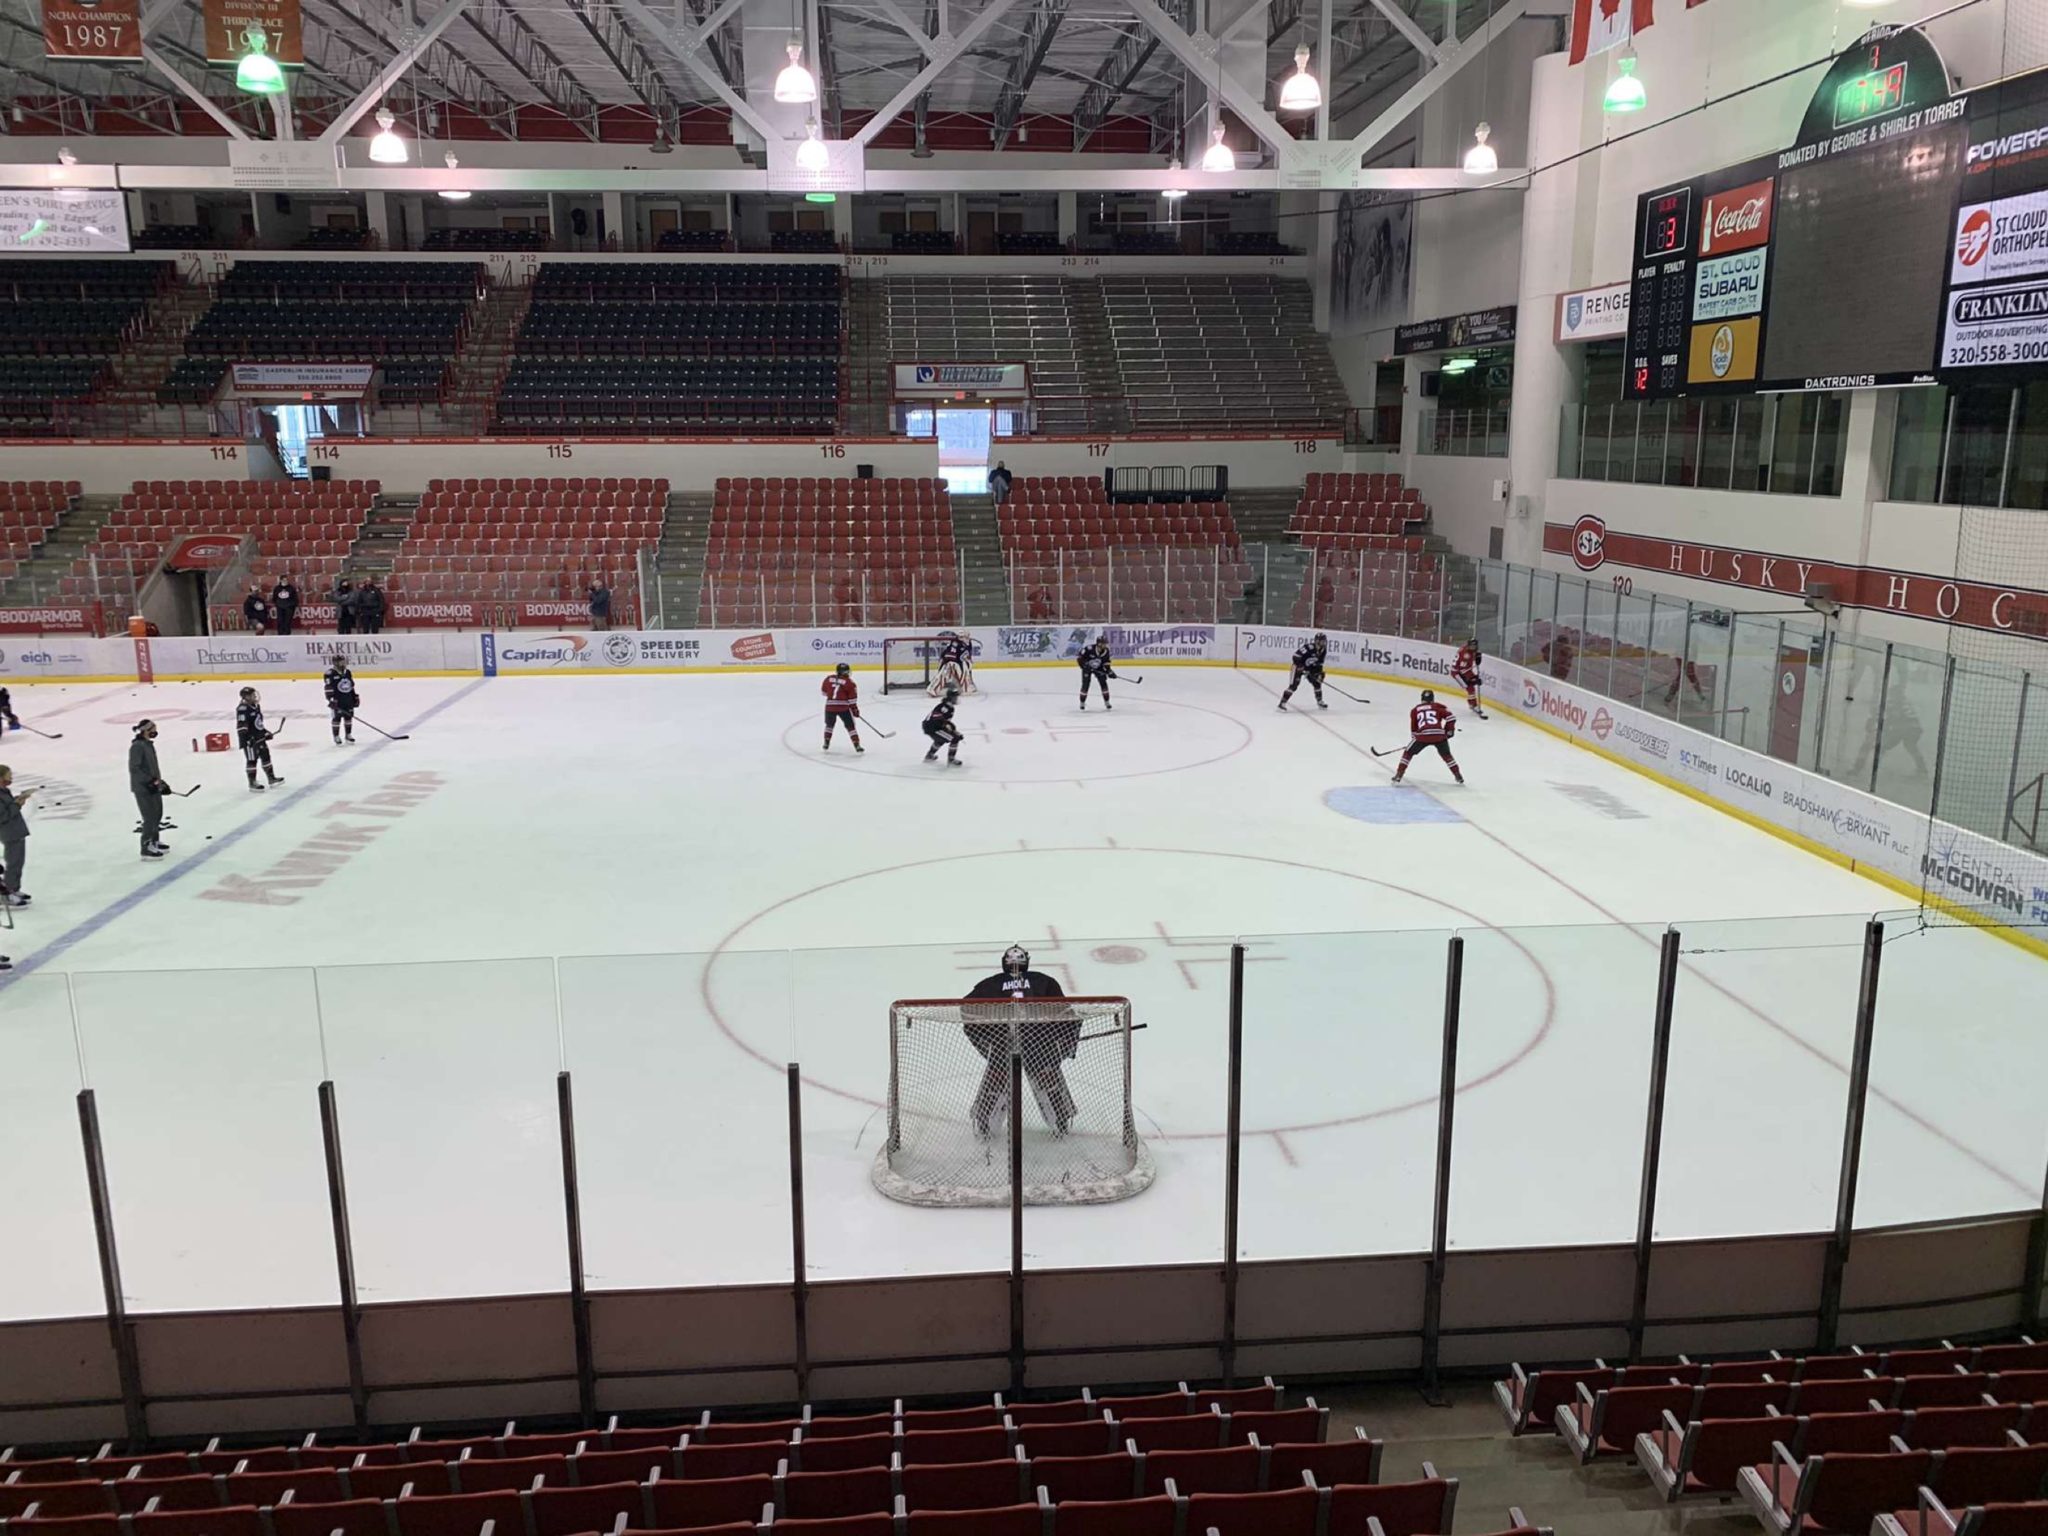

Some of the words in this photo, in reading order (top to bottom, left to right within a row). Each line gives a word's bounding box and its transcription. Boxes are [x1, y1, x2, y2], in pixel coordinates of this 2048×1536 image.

[48, 11, 78, 21] NCHA
[78, 12, 132, 22] CHAMPION
[62, 25, 122, 48] 1987
[225, 29, 284, 53] 197
[1778, 144, 1817, 169] DONATED
[1818, 140, 1831, 157] BY
[1831, 128, 1868, 153] GEORGE
[1869, 125, 1877, 141] &
[1879, 113, 1922, 139] SHIRLEY
[1924, 97, 1968, 126] TORREY
[1994, 216, 2009, 236] ST
[2010, 209, 2047, 233] CLOUD
[181, 252, 199, 261] 210
[212, 252, 229, 261] 211
[489, 254, 505, 262] 211
[520, 254, 537, 263] 212
[846, 256, 863, 265] 212
[871, 256, 888, 265] 213
[1061, 257, 1077, 266] 213
[1084, 257, 1100, 266] 214
[1269, 257, 1285, 266] 214
[1637, 266, 1657, 280] PLAYER
[1663, 260, 1686, 275] PENALTY
[1700, 264, 1719, 279] ST.
[1720, 255, 1760, 276] CLOUD
[1699, 274, 1760, 300] SUBARU
[1585, 292, 1630, 315] RENGE
[1958, 290, 2048, 321] FRANKLIN
[1956, 329, 1994, 342] OUTDOOR
[1995, 323, 2048, 338] ADVERTISING
[1949, 341, 2048, 365] 320-558-3000
[940, 366, 1004, 383] ULTIMATE
[1635, 368, 1648, 390] 12
[1804, 374, 1876, 389] DAKTRONICS
[210, 446, 238, 460] 114
[313, 446, 340, 459] 114
[546, 444, 573, 458] 115
[820, 445, 846, 459] 116
[1086, 443, 1110, 457] 117
[1293, 440, 1317, 454] 118
[1670, 544, 1813, 593] HUSKY
[0, 609, 83, 624] BODYARMOR
[393, 604, 473, 618] BODYARMOR
[525, 603, 592, 617] BODYARMO
[1171, 628, 1208, 644] PLUS
[306, 641, 393, 655] HEARTLAND
[674, 640, 700, 649] DEE
[825, 639, 847, 649] Gate
[847, 639, 868, 651] City
[1110, 646, 1142, 656] EDERAL
[1143, 646, 1173, 656] CREDIT
[1176, 646, 1202, 656] UNION
[1260, 634, 1295, 649] POWER
[1342, 641, 1357, 655] MN
[21, 651, 52, 663] eich
[197, 647, 288, 664] PreferredOne
[358, 655, 379, 666] LLC
[641, 650, 700, 660] DELIVERY
[1360, 646, 1392, 665] HRS
[1401, 653, 1451, 676] Rentals
[831, 684, 841, 700] 7
[1541, 689, 1588, 731] Holiday
[1416, 710, 1439, 728] 25
[1692, 753, 1718, 775] Times
[1726, 767, 1772, 798] LOCALiQ
[1782, 791, 1836, 823] BRADSHAW
[1847, 817, 1891, 846] BRYANT
[1891, 840, 1910, 856] PLLC
[1951, 850, 2025, 893] CENTRAL
[1920, 853, 2024, 915] McGOWAN
